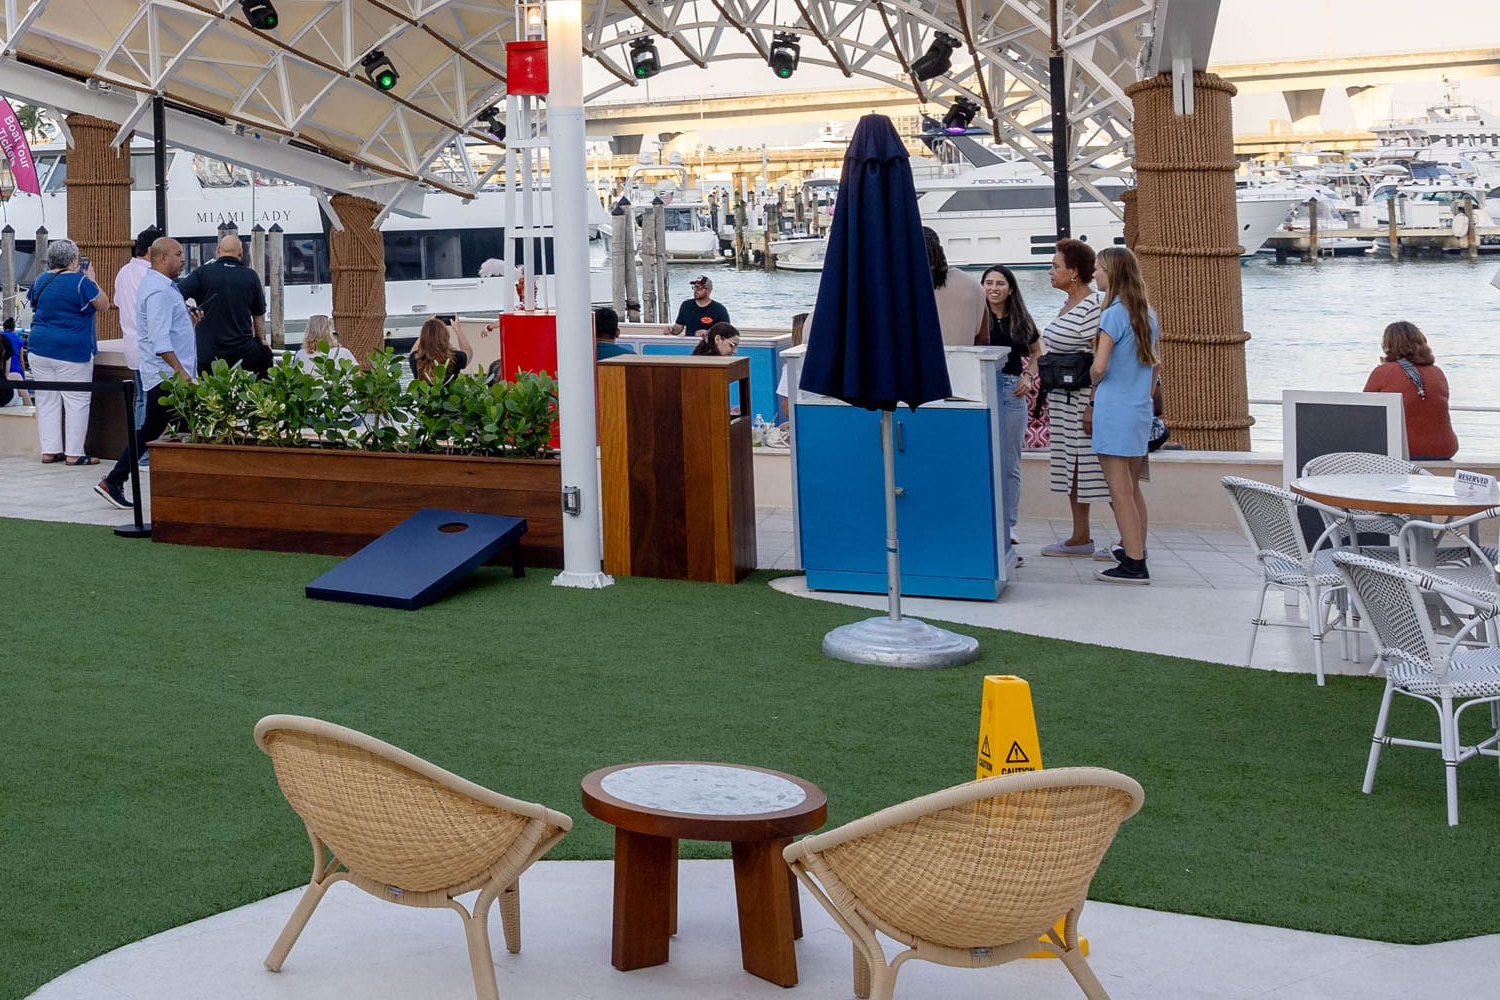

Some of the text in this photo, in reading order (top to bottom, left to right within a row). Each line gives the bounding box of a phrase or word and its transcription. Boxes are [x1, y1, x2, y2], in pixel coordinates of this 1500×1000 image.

[4, 115, 30, 169] Boat Tour
[197, 210, 292, 223] MIAMI LADY
[1458, 473, 1489, 485] RESERVED
